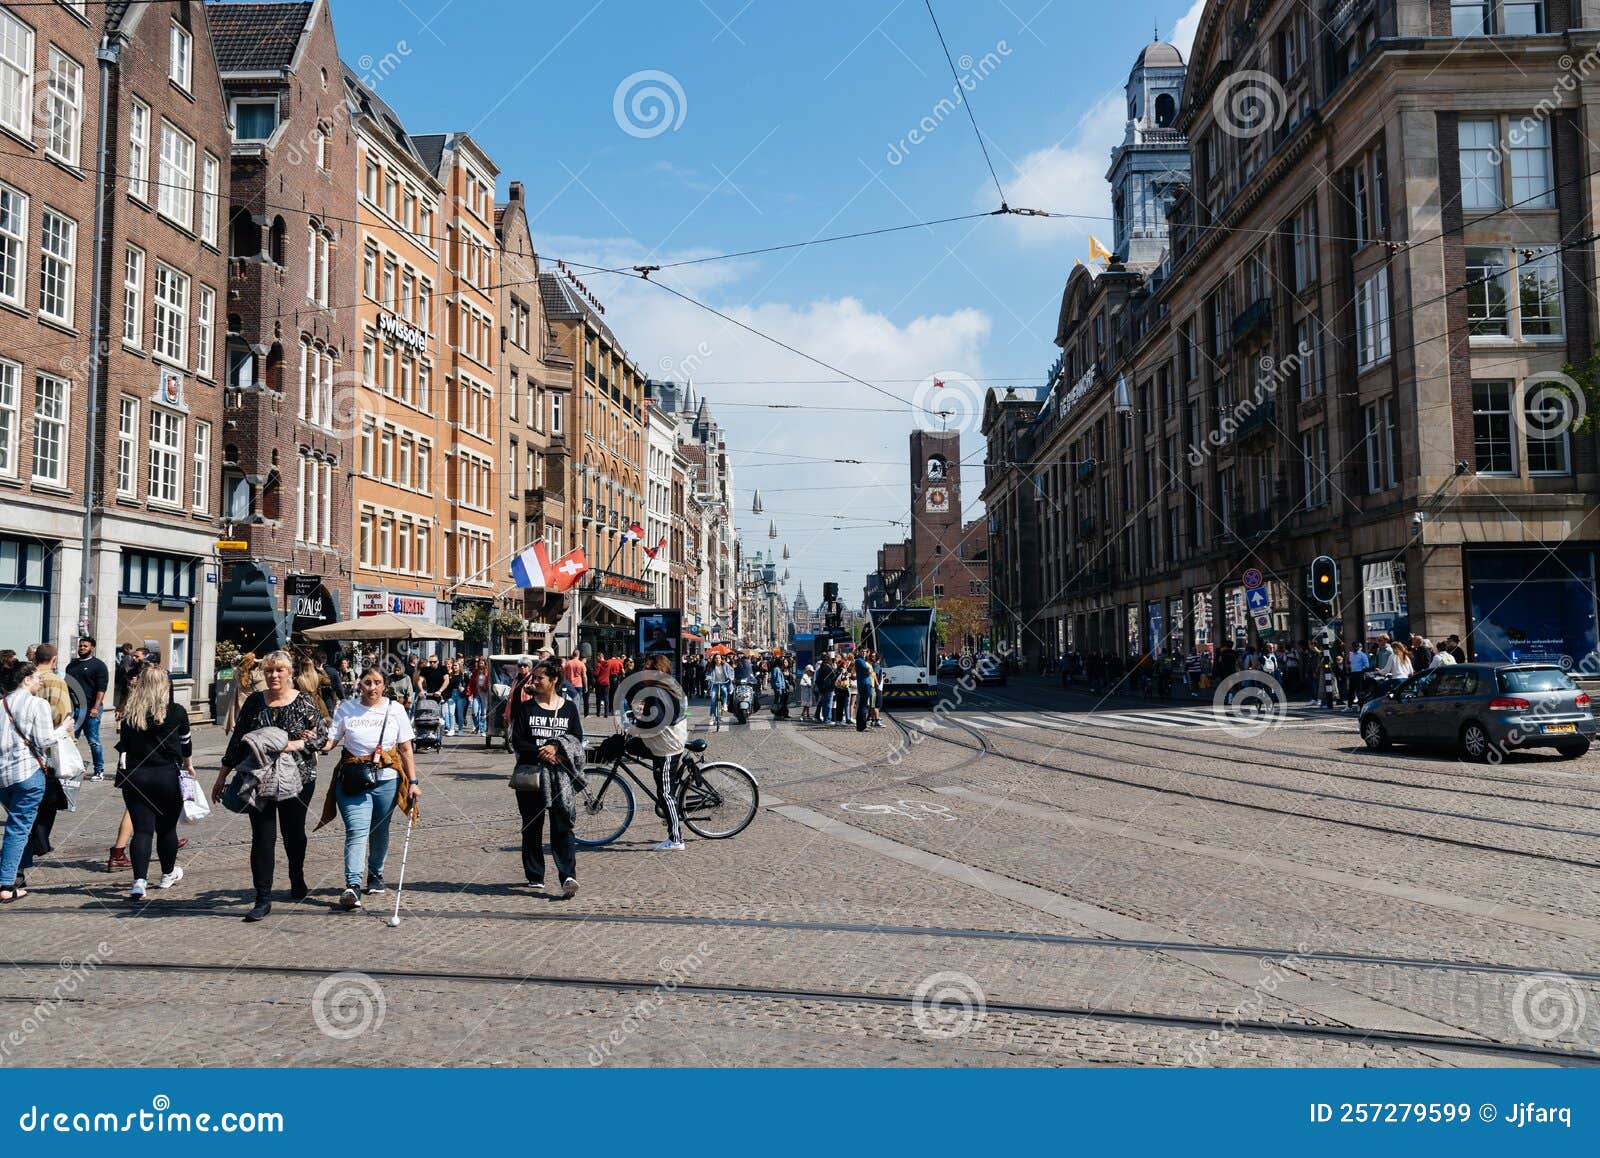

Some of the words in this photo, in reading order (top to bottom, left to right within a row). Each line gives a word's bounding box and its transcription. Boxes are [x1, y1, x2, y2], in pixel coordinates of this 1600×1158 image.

[529, 716, 548, 726] NEW
[548, 717, 569, 728] YORK
[531, 728, 566, 737] MANHATAN
